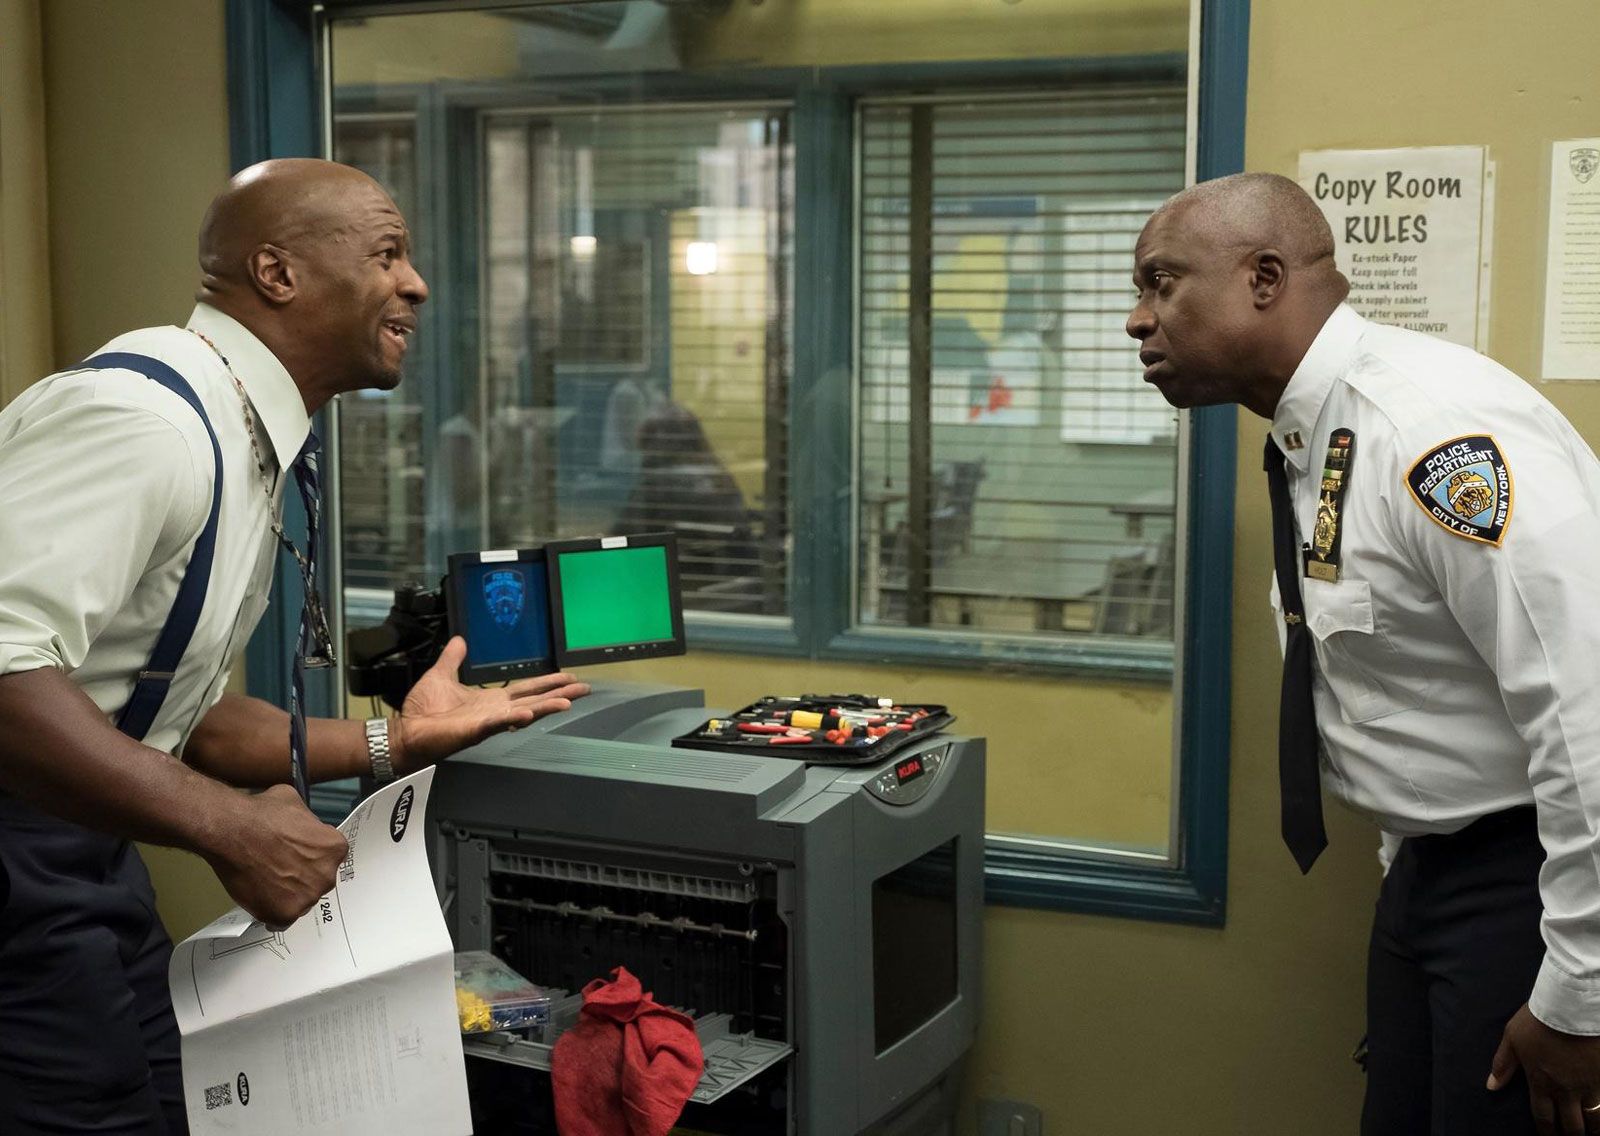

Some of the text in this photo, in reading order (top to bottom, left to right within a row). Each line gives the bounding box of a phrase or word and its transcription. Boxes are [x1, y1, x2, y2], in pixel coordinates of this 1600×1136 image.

[1315, 171, 1461, 205] Copy Room
[1345, 214, 1427, 244] RULES
[1392, 253, 1417, 263] Paper
[1351, 267, 1417, 278] Keep copier full
[1350, 281, 1417, 291] Check ink levels
[1366, 296, 1392, 305] supply
[1395, 296, 1427, 304] cabinet
[1368, 309, 1391, 318] after
[1394, 309, 1429, 320] yourself
[1425, 442, 1472, 473] POLICE
[1419, 450, 1494, 496] DEPARTMENT
[1494, 464, 1509, 527] NEW YORK
[1432, 506, 1479, 535] CITY OF
[320, 902, 333, 924] 242
